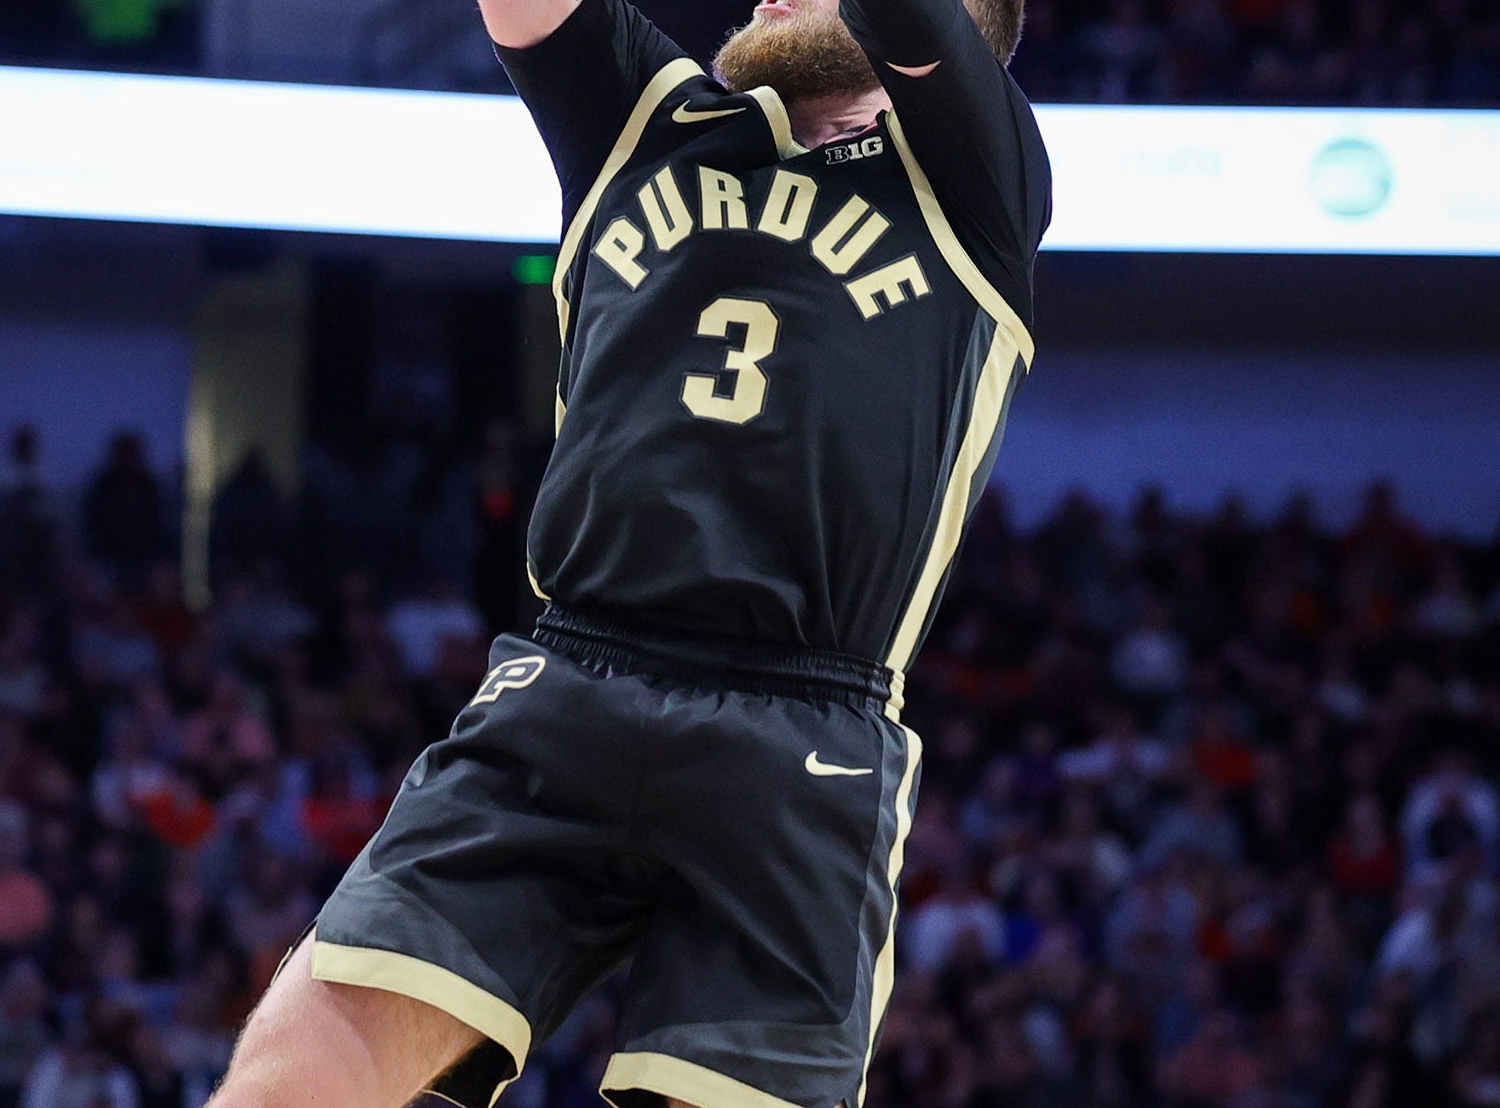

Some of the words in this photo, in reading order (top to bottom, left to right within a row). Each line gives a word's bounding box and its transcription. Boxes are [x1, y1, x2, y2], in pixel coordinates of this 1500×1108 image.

[591, 165, 933, 322] PURDUE
[680, 296, 781, 426] 3
[469, 655, 546, 707] P
